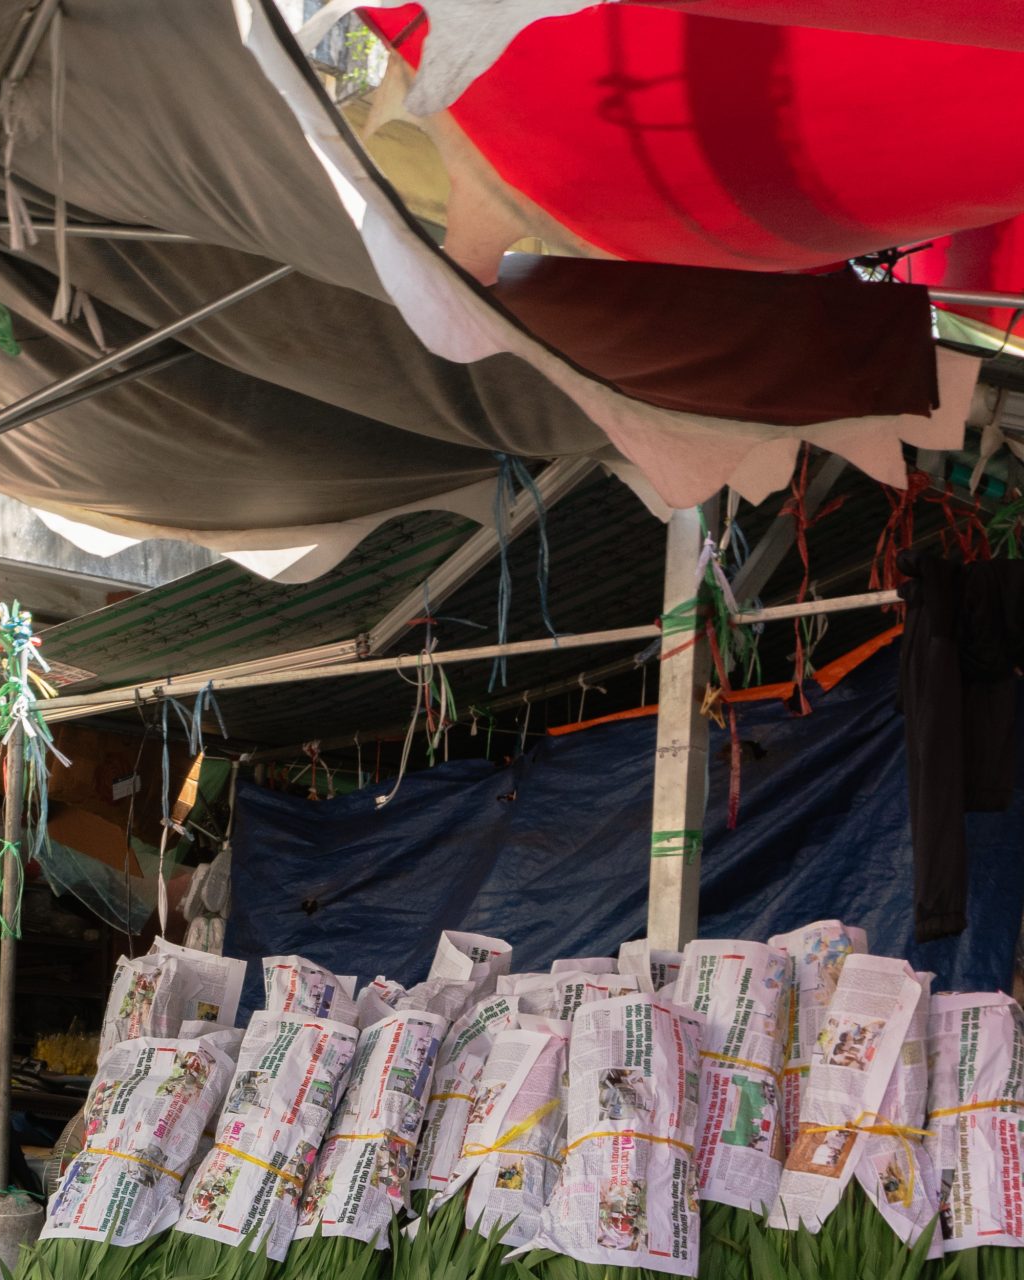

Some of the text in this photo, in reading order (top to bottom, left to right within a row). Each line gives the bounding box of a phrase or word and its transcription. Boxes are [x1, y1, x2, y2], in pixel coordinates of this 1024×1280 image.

[154, 1122, 166, 1139] Gen
[231, 1120, 245, 1136] Gen
[354, 1183, 364, 1202] động
[360, 1169, 368, 1183] cho
[241, 1218, 252, 1235] Giáo
